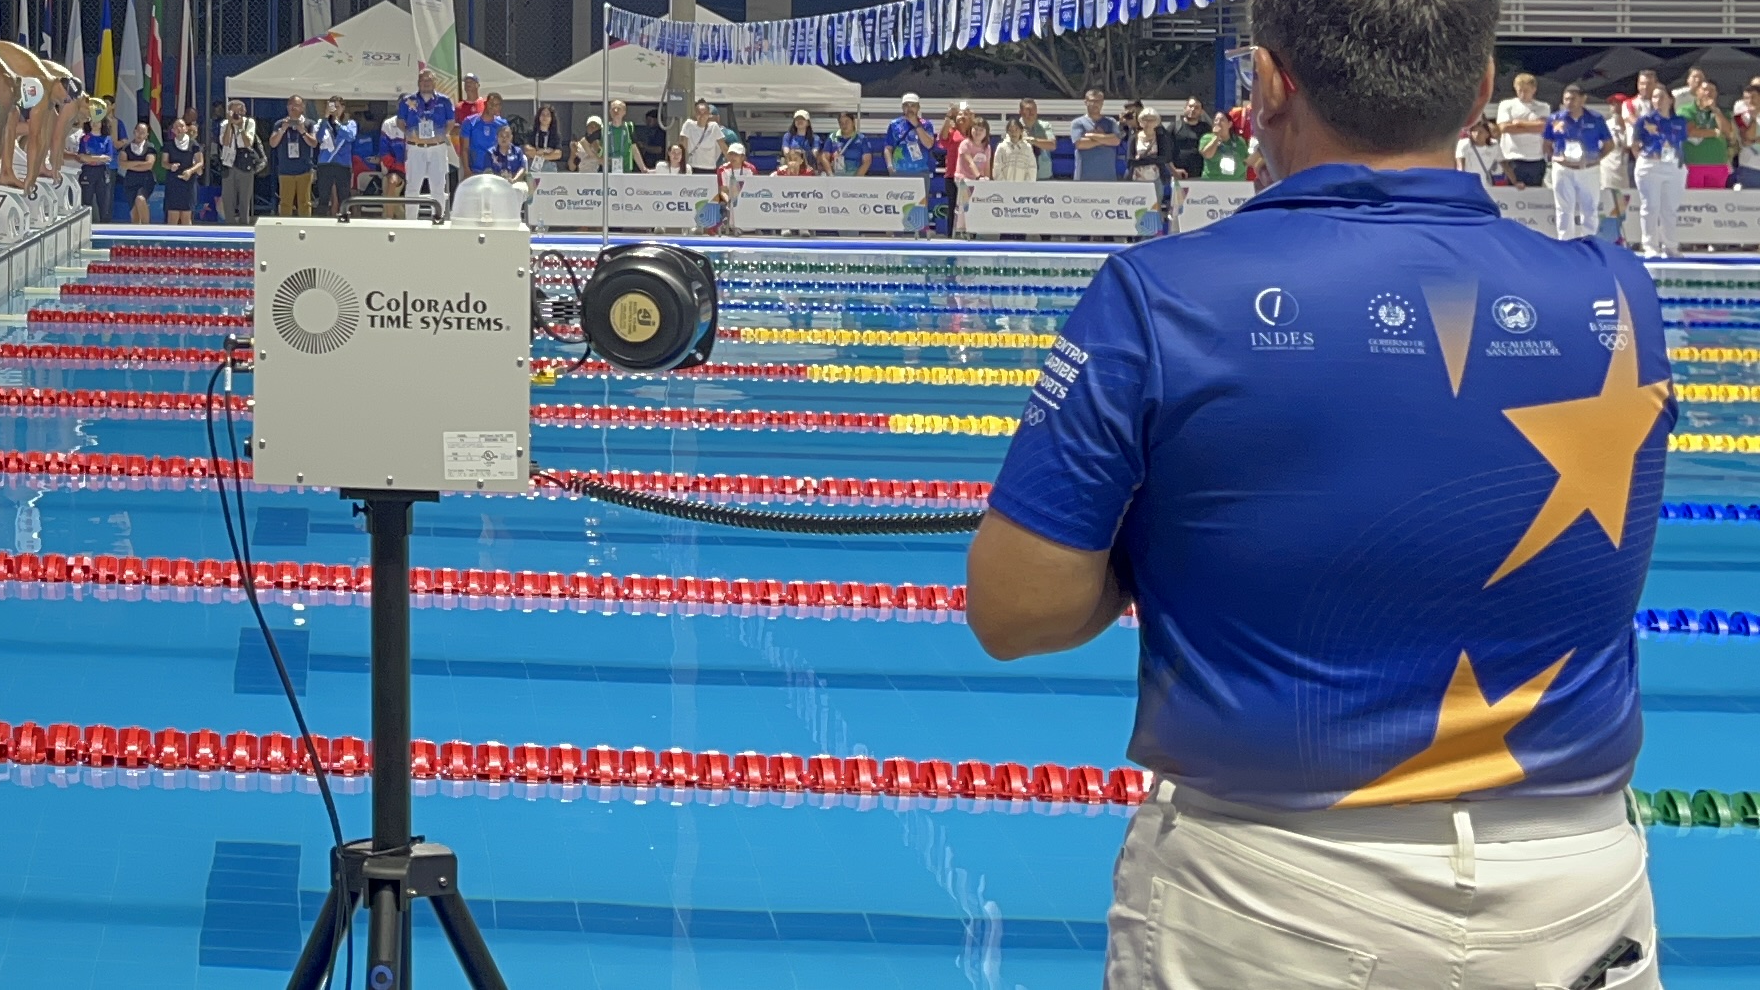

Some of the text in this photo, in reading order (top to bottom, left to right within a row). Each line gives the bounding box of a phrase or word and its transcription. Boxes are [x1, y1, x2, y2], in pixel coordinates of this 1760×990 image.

[28, 184, 38, 201] 8
[585, 200, 602, 208] City
[666, 201, 693, 212] CEL
[790, 202, 808, 211] City
[873, 205, 900, 215] CEL
[1022, 208, 1039, 216] City
[1105, 210, 1133, 220] CEL
[366, 314, 413, 329] TIME
[1250, 331, 1315, 346] INDES
[1055, 335, 1089, 365] ENTRO
[1044, 352, 1080, 384] ARIBE
